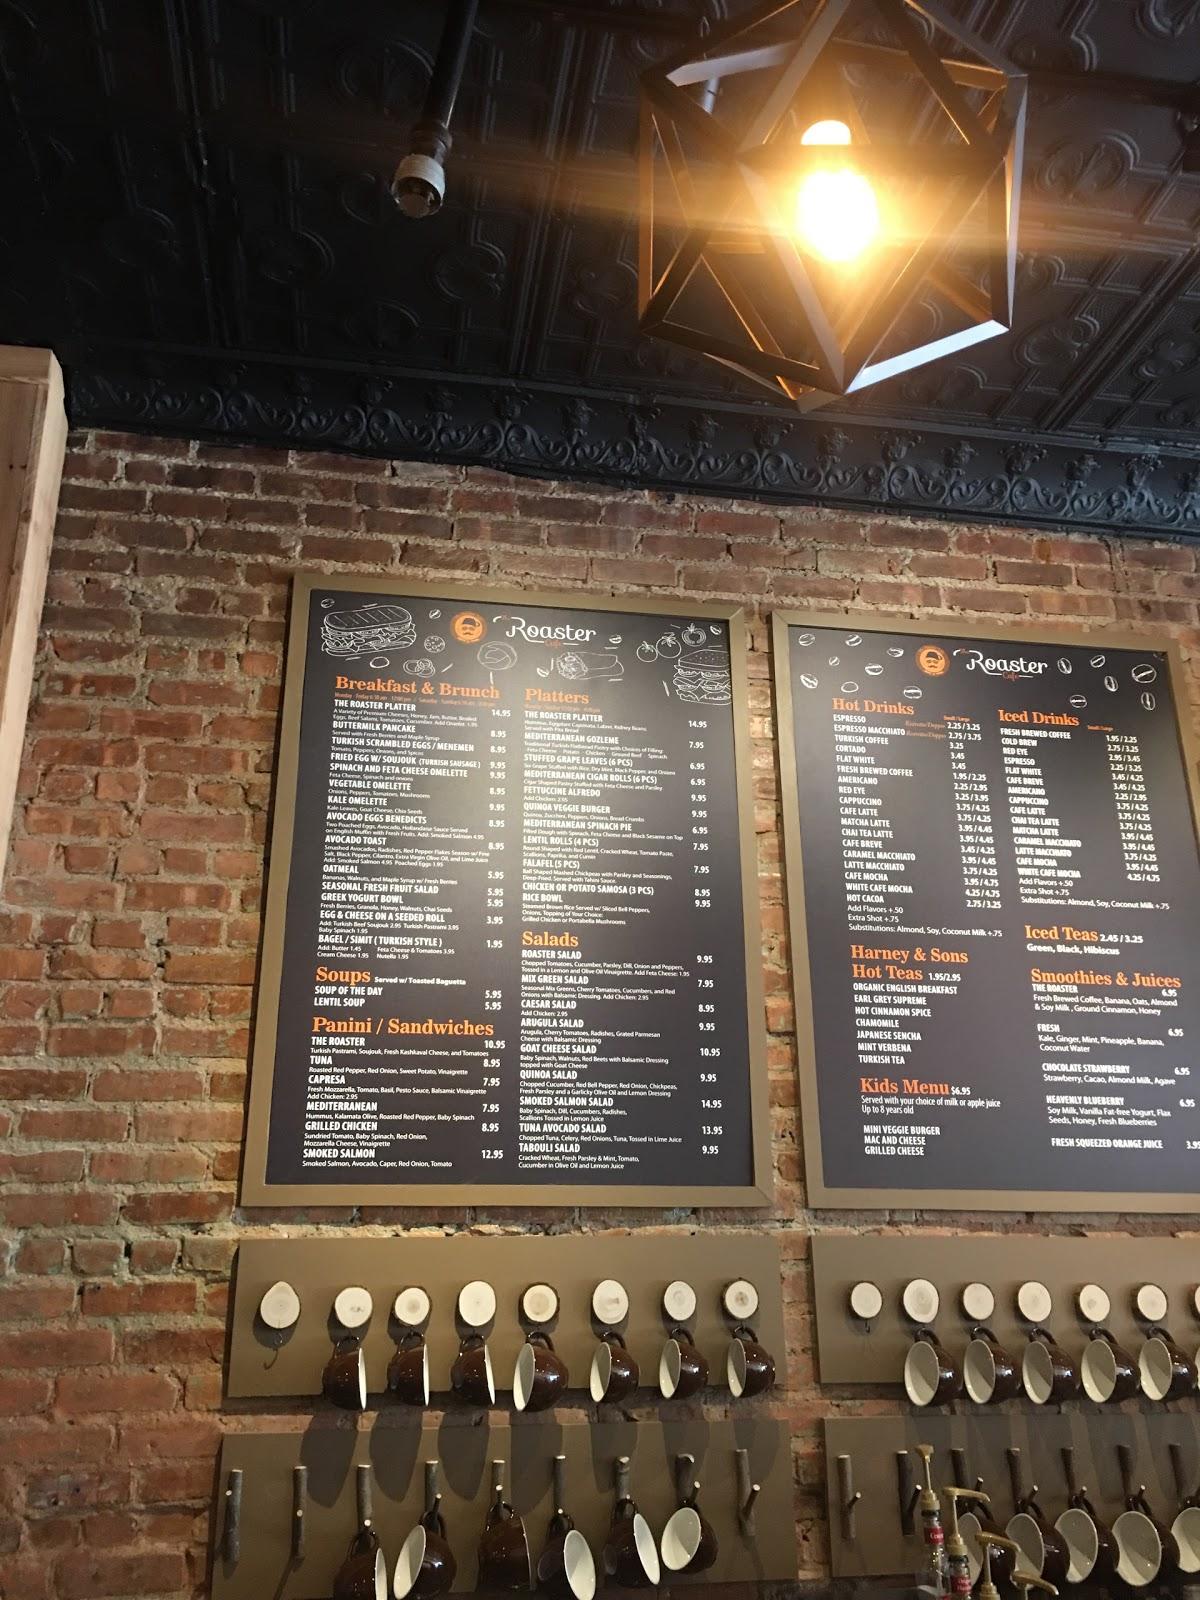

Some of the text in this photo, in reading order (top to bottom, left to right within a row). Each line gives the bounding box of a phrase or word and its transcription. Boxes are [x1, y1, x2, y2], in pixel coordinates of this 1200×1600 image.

[506, 616, 596, 643] Roaster
[966, 650, 1048, 676] Roaster
[335, 676, 500, 698] Breakfast & Brunch
[524, 688, 590, 704] Platters
[334, 700, 348, 708] THE
[350, 701, 383, 710] ROASTER
[384, 703, 416, 711] PLATTER
[832, 698, 915, 715] Hot Drinks
[491, 709, 511, 717] 14.95
[524, 711, 603, 722] THE ROASTER PLATTER
[998, 709, 1080, 726] Iced Drinks
[834, 714, 866, 723] ESPRESSO
[333, 721, 416, 732] BUTTERMILK PANCAKE
[688, 720, 707, 729] 14.95
[835, 734, 888, 744] TURKISH COFFEE
[1001, 738, 1018, 746] COLD
[332, 737, 474, 752] TURKISH SCRAMBLED EGGS / MENEMEN
[329, 780, 411, 791] VEGETABLE OMELETTE
[328, 796, 387, 805] KALE OMELETTE
[840, 807, 878, 816] CAFE LATTE
[327, 812, 426, 824] AVOCADO EGGS BENEDICTS
[325, 835, 386, 845] AVOCADO TOAST
[323, 865, 359, 873] OATMEAL
[523, 859, 580, 870] FALAFEL (5 PCS)
[694, 866, 709, 874] 7.95
[487, 871, 504, 879] 5.95
[322, 882, 439, 894] SEASONAL FRESH FRUIT SALAD
[487, 888, 504, 896] 5.95
[321, 893, 403, 904] GREEK YOGURT BOWL
[487, 899, 503, 907] 5.95
[847, 894, 884, 903] HOT CACOA
[1024, 925, 1098, 942] Iced Teas
[522, 931, 579, 947] Salads
[522, 950, 582, 959] ROASTER SALAD
[850, 945, 968, 964] Harney & Sons
[316, 967, 371, 986] Soups
[852, 964, 961, 981] Hot Teas 1.95/2.95
[1031, 968, 1181, 988] Smoothies & Juices
[315, 986, 383, 996] SOUP OF THE DAY
[853, 983, 958, 994] ORGANIC ENGLISH BREAKFAST
[485, 990, 502, 998] 5.95
[314, 998, 365, 1007] LENTIL SOUP
[484, 1002, 501, 1010] 5.95
[521, 1000, 576, 1009] CAESAR SALAD
[698, 1005, 714, 1013] 8.95
[311, 1016, 494, 1036] Panini / Sandwiches
[856, 1018, 899, 1028] CHAMOMILE
[1037, 1023, 1060, 1032] FRESH
[311, 1037, 365, 1046] THE ROASTER
[484, 1041, 505, 1049] 10.95
[521, 1044, 597, 1054] GOAT CHEESE SALAD
[700, 1048, 720, 1056] 10.95
[858, 1043, 911, 1052] MINT VERBENA
[310, 1056, 332, 1065] TUNA
[483, 1059, 501, 1067] 8.95
[308, 1075, 345, 1084] CAPRESA
[483, 1078, 500, 1086] 7.95
[860, 1078, 971, 1095] Kids Menu $6.95
[306, 1102, 377, 1111] MEDITERRANEAN
[482, 1104, 499, 1112] 7.95
[862, 1105, 871, 1114] Up
[886, 1107, 903, 1115] years
[904, 1106, 914, 1114] old
[305, 1122, 377, 1131] GRILLED CHICKEN
[482, 1123, 499, 1132] 8.95
[864, 1136, 926, 1145] MAC AND CHEESE
[519, 1143, 580, 1153] TABOULI SALAD
[702, 1146, 719, 1154] 9.95
[865, 1147, 924, 1156] GRILLED CHEESE
[303, 1149, 375, 1158] SMOKED SALMON
[481, 1150, 503, 1159] 12.95
